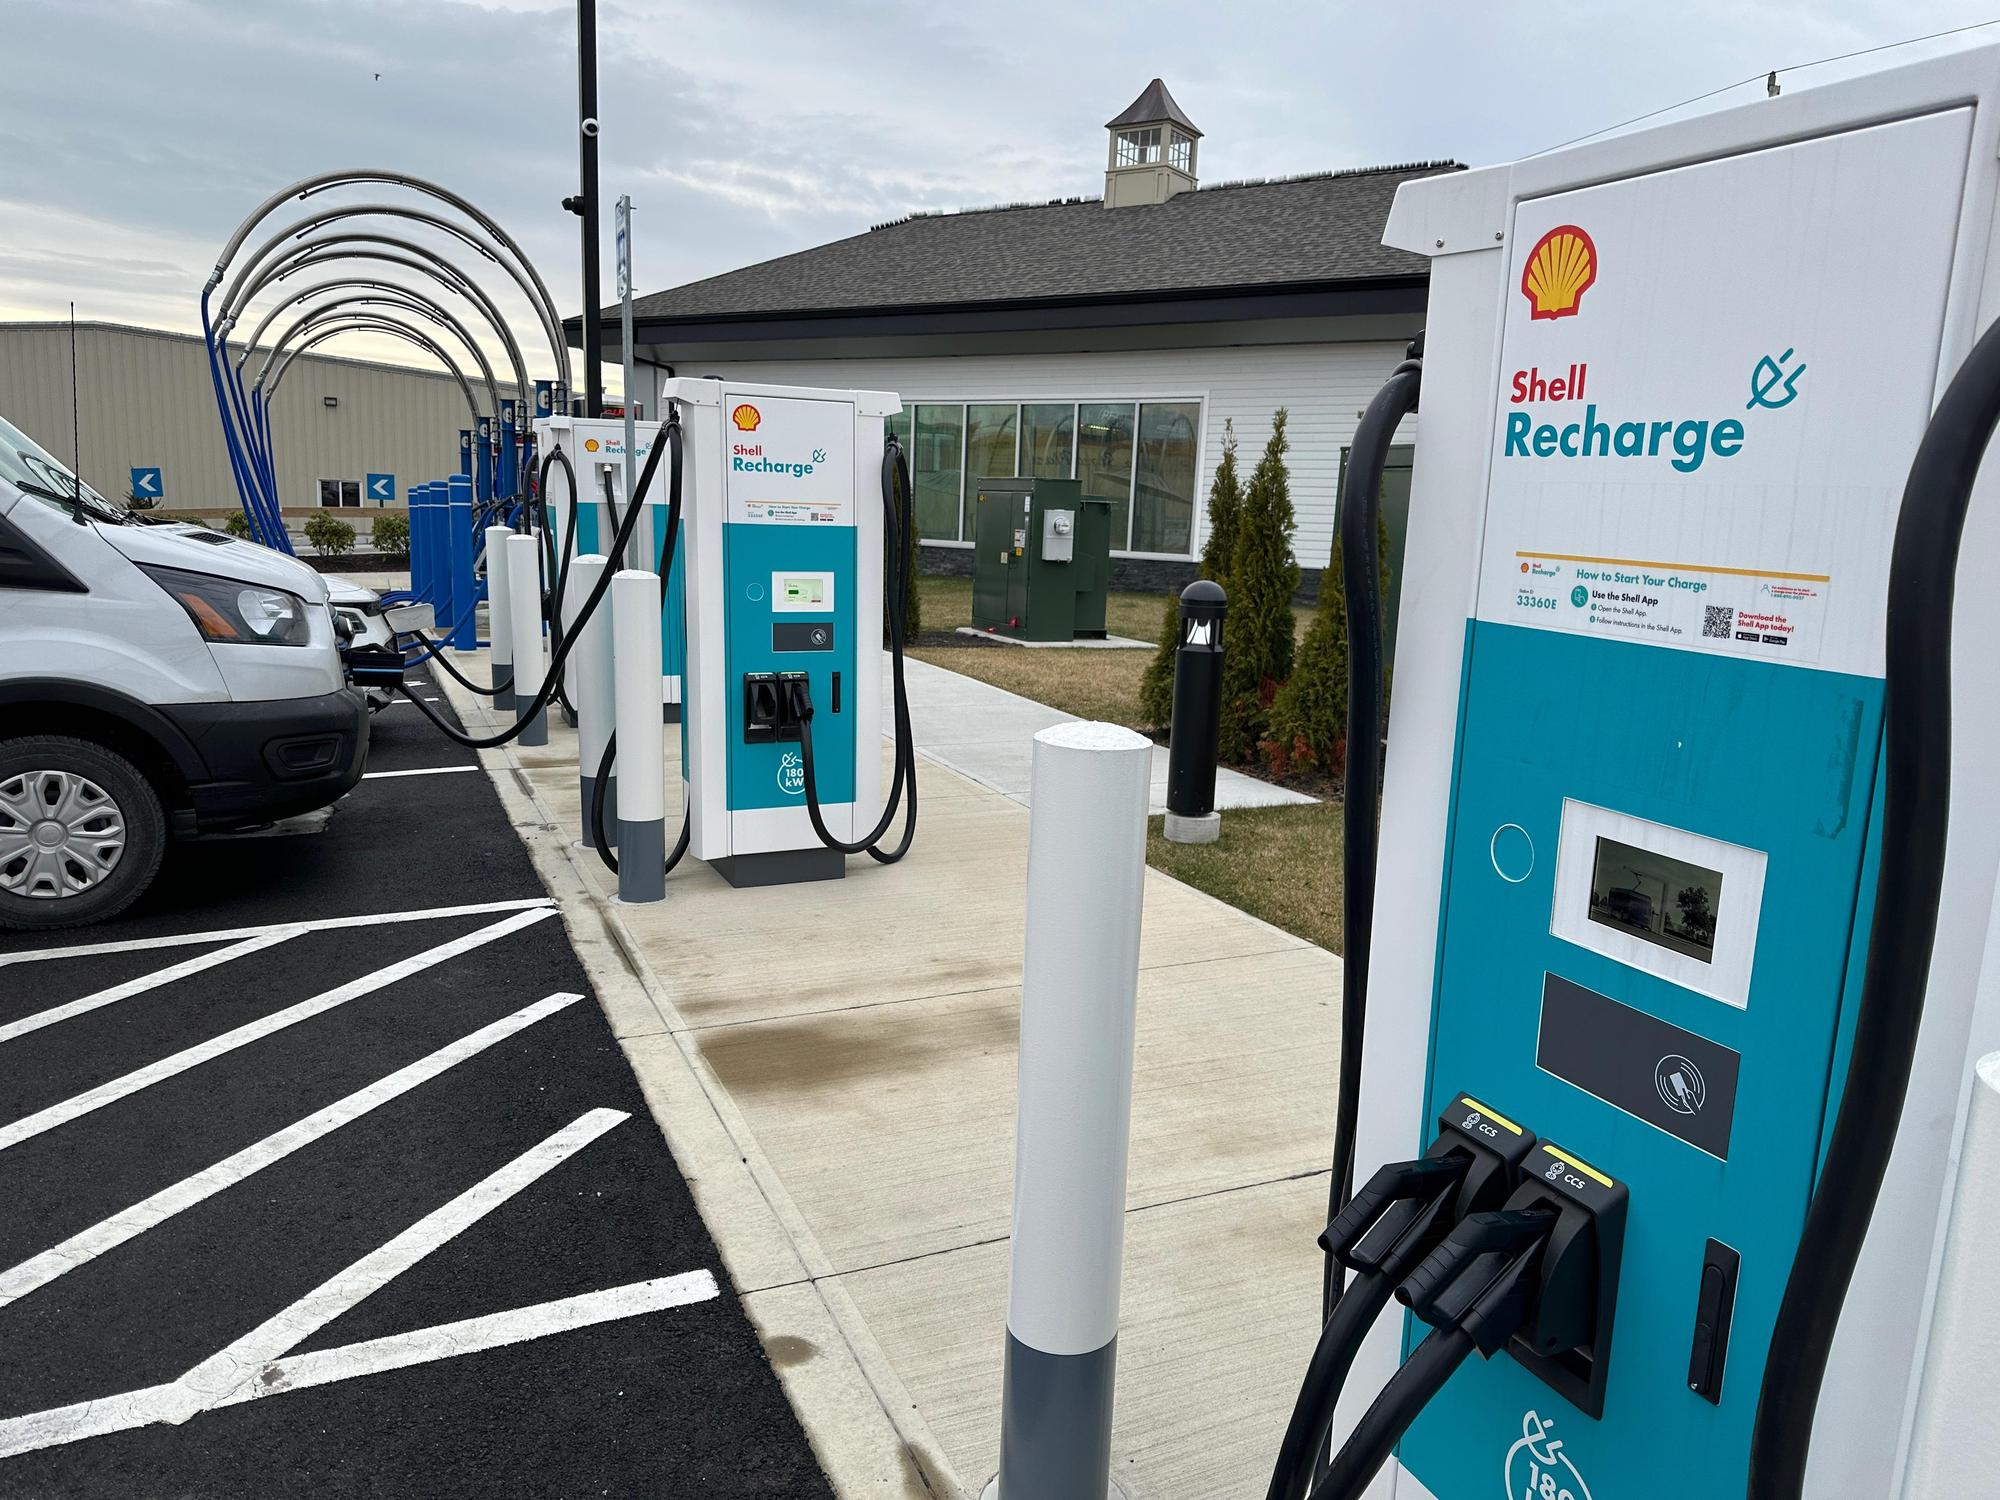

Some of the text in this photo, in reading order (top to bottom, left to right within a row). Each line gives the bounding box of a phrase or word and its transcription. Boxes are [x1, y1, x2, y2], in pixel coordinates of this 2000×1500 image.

[1510, 364, 1587, 403] Shell
[1504, 404, 1745, 473] Recharge
[606, 446, 646, 456] Rechge
[733, 444, 762, 456] Shell
[733, 457, 814, 478] Recharge
[1576, 569, 1707, 593] How to Start Your Charge
[1516, 595, 1557, 609] 33360E
[1592, 590, 1658, 607] Use the Shell App
[1598, 605, 1612, 613] Open
[1596, 617, 1612, 625] Follow
[1613, 618, 1640, 628] instructions
[1738, 612, 1774, 622] Download
[1755, 622, 1769, 631] App
[1771, 624, 1794, 633] today!
[786, 768, 804, 777] 180
[785, 778, 804, 787] kW
[1478, 1123, 1498, 1138] CCS
[1564, 1174, 1585, 1190] CCS
